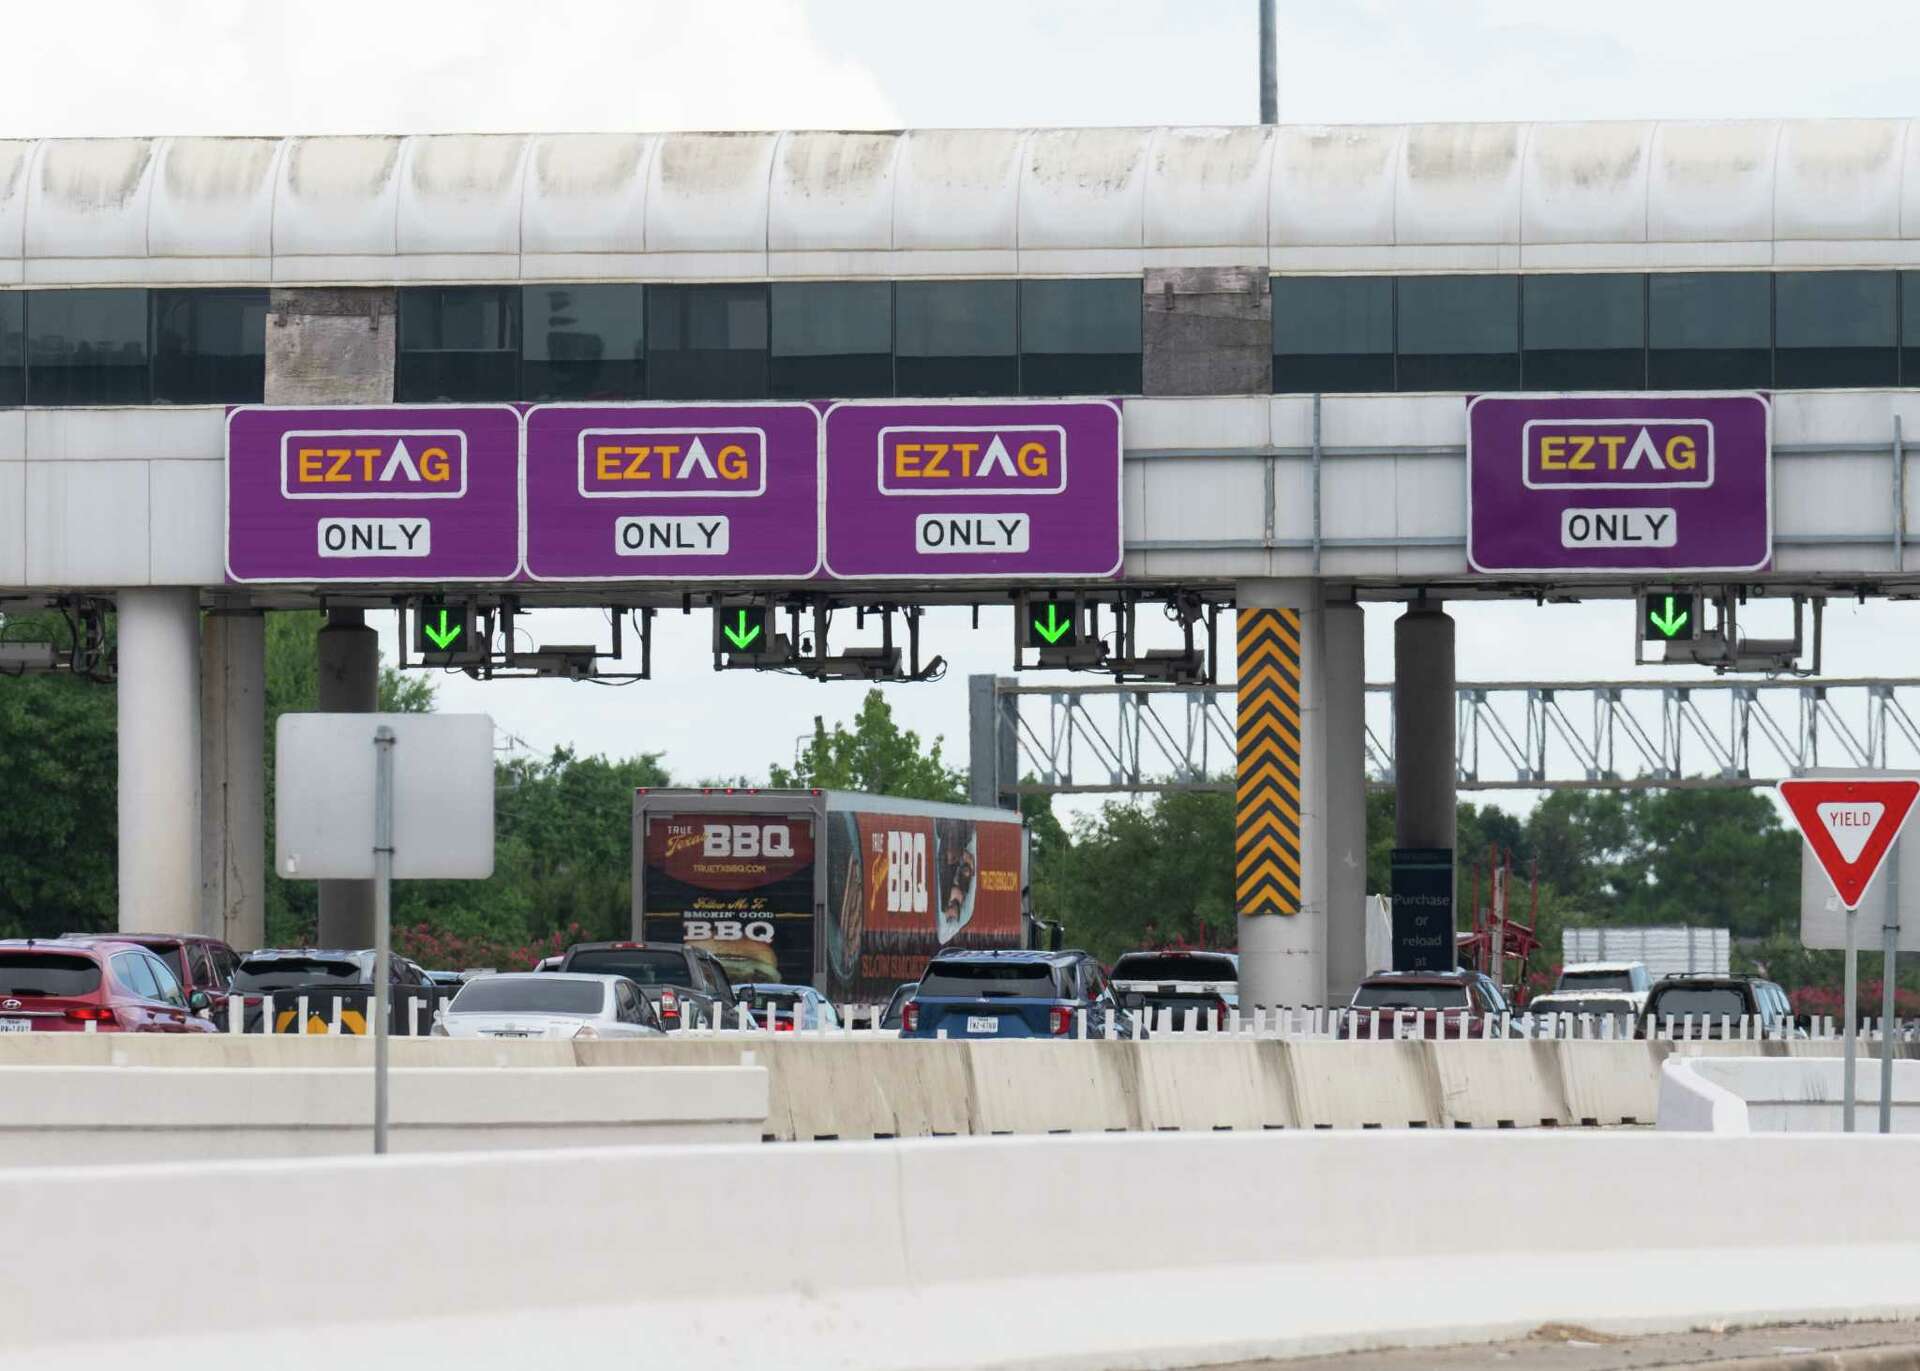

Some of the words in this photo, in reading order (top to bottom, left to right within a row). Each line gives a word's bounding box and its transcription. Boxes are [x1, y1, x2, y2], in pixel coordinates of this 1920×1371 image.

[324, 524, 422, 551] ONLY
[622, 521, 722, 549] ONLY
[922, 519, 1022, 547] ONLY
[1568, 514, 1669, 542] ONLY
[1829, 811, 1872, 827] YIELD
[667, 825, 692, 836] TRUE
[703, 824, 795, 858] BBQ
[887, 830, 928, 913] BBQ
[1393, 893, 1450, 906] Purchase
[683, 911, 735, 919] SMOKIN'
[739, 911, 774, 919] GOOD
[1415, 916, 1429, 927] or
[683, 921, 775, 944] BBQ
[1402, 933, 1442, 946] reload
[1415, 956, 1428, 968] at
